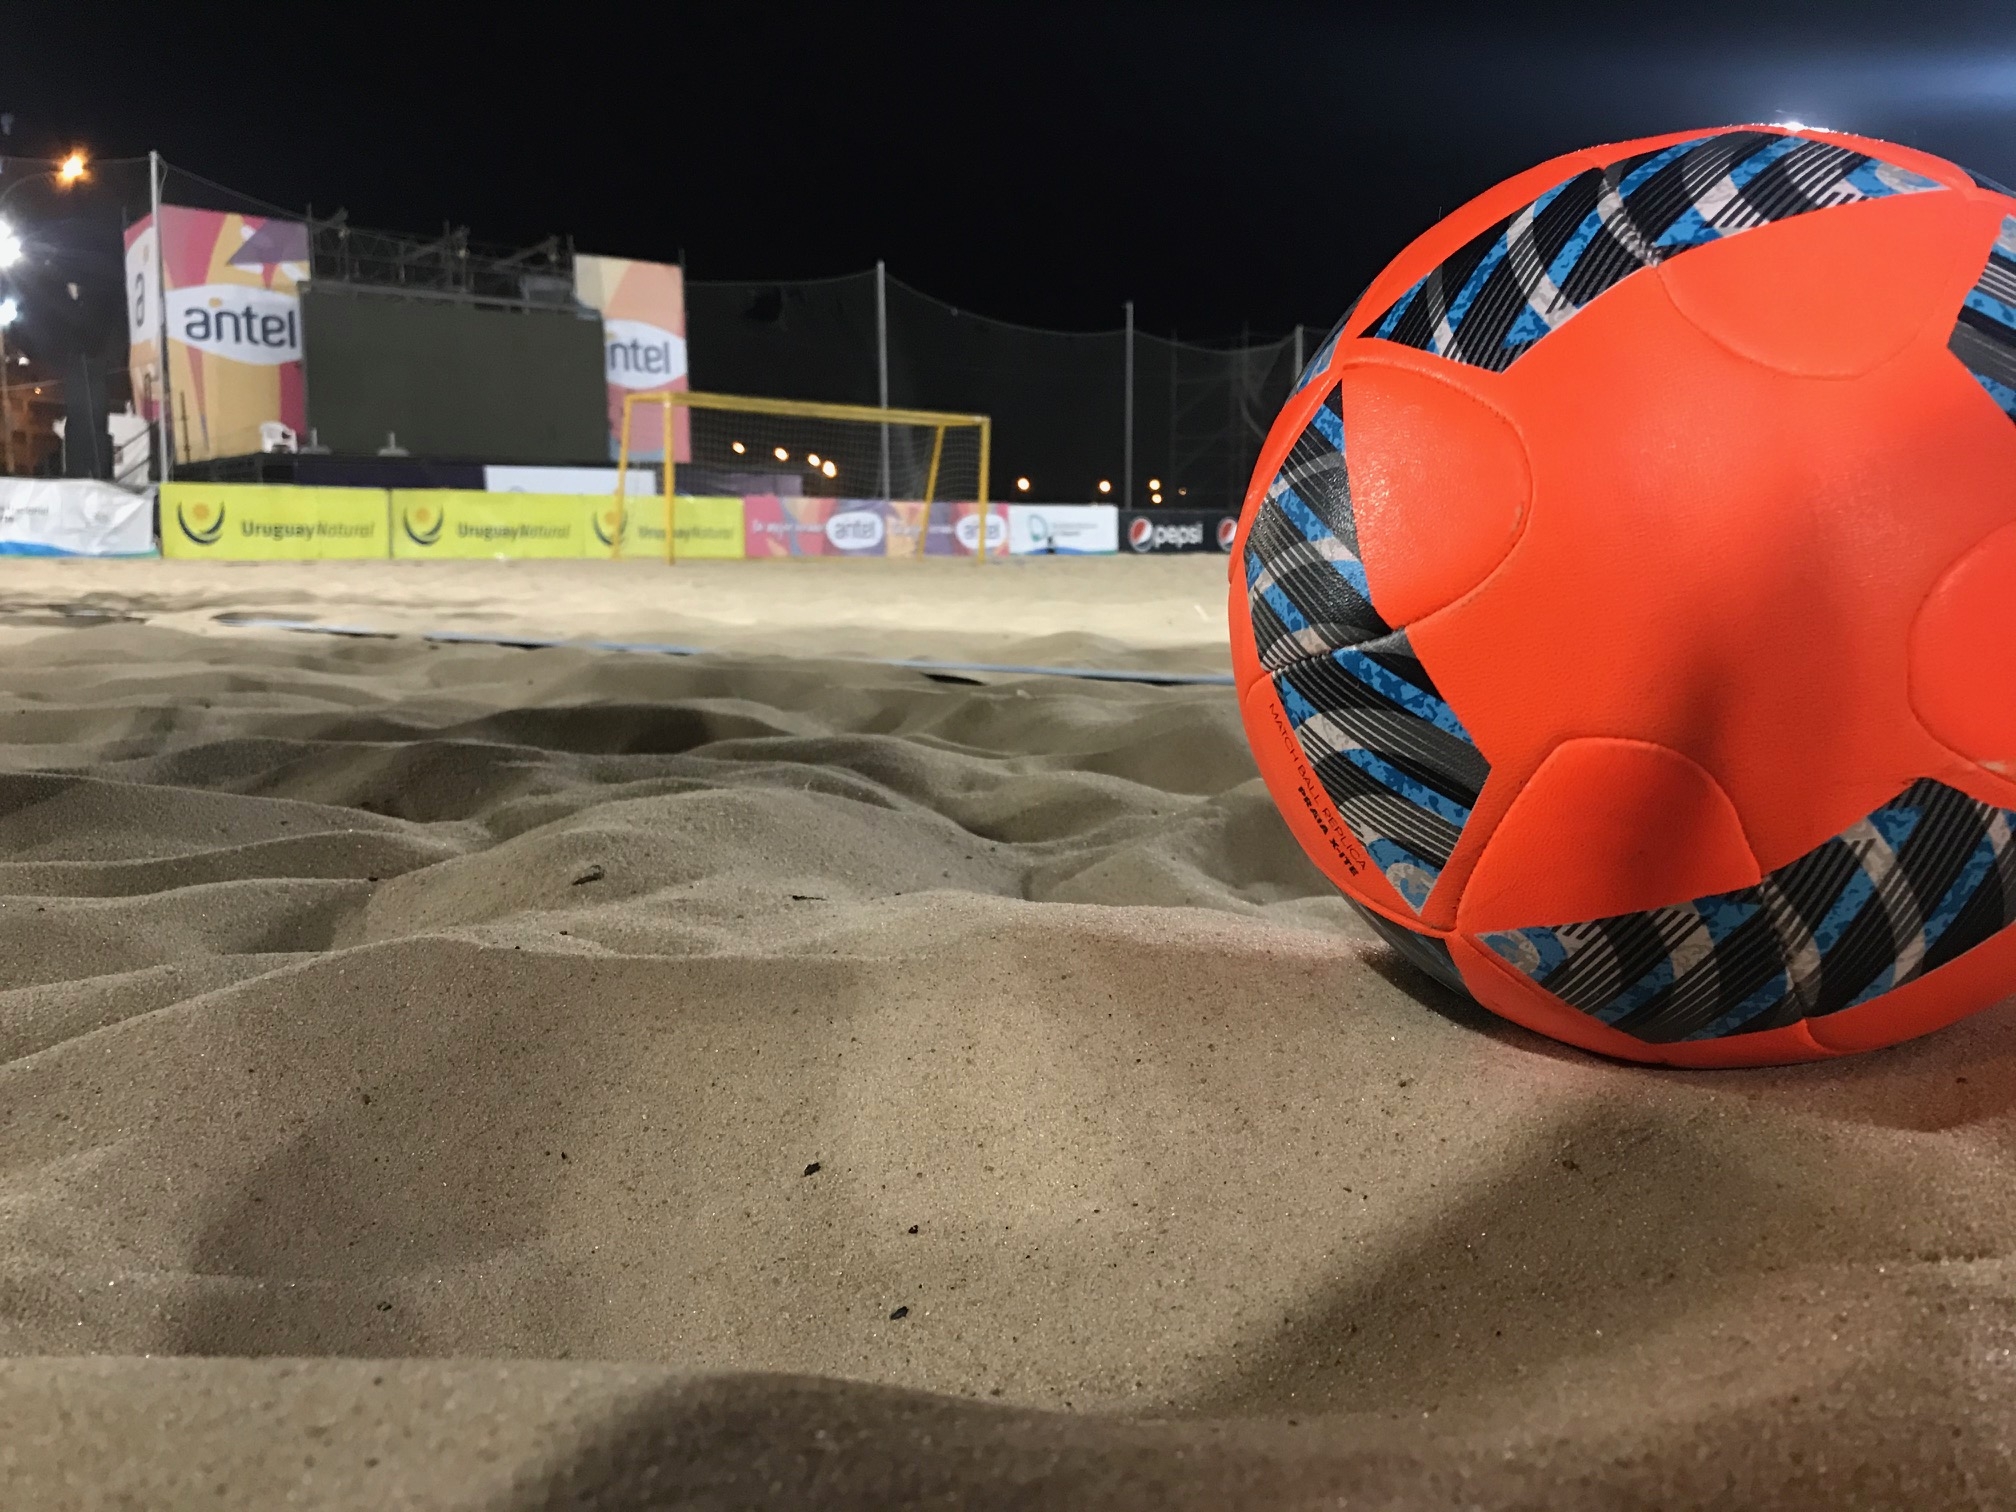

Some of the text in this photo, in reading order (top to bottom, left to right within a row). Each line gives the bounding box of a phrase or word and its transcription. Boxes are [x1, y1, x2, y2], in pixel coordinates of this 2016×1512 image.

[184, 305, 297, 349] antel
[610, 338, 670, 375] ntel
[1152, 521, 1204, 549] pepsi
[1269, 703, 1367, 871] MATCH BALL REPLICA
[1298, 786, 1359, 877] PRAIA X-ITE
